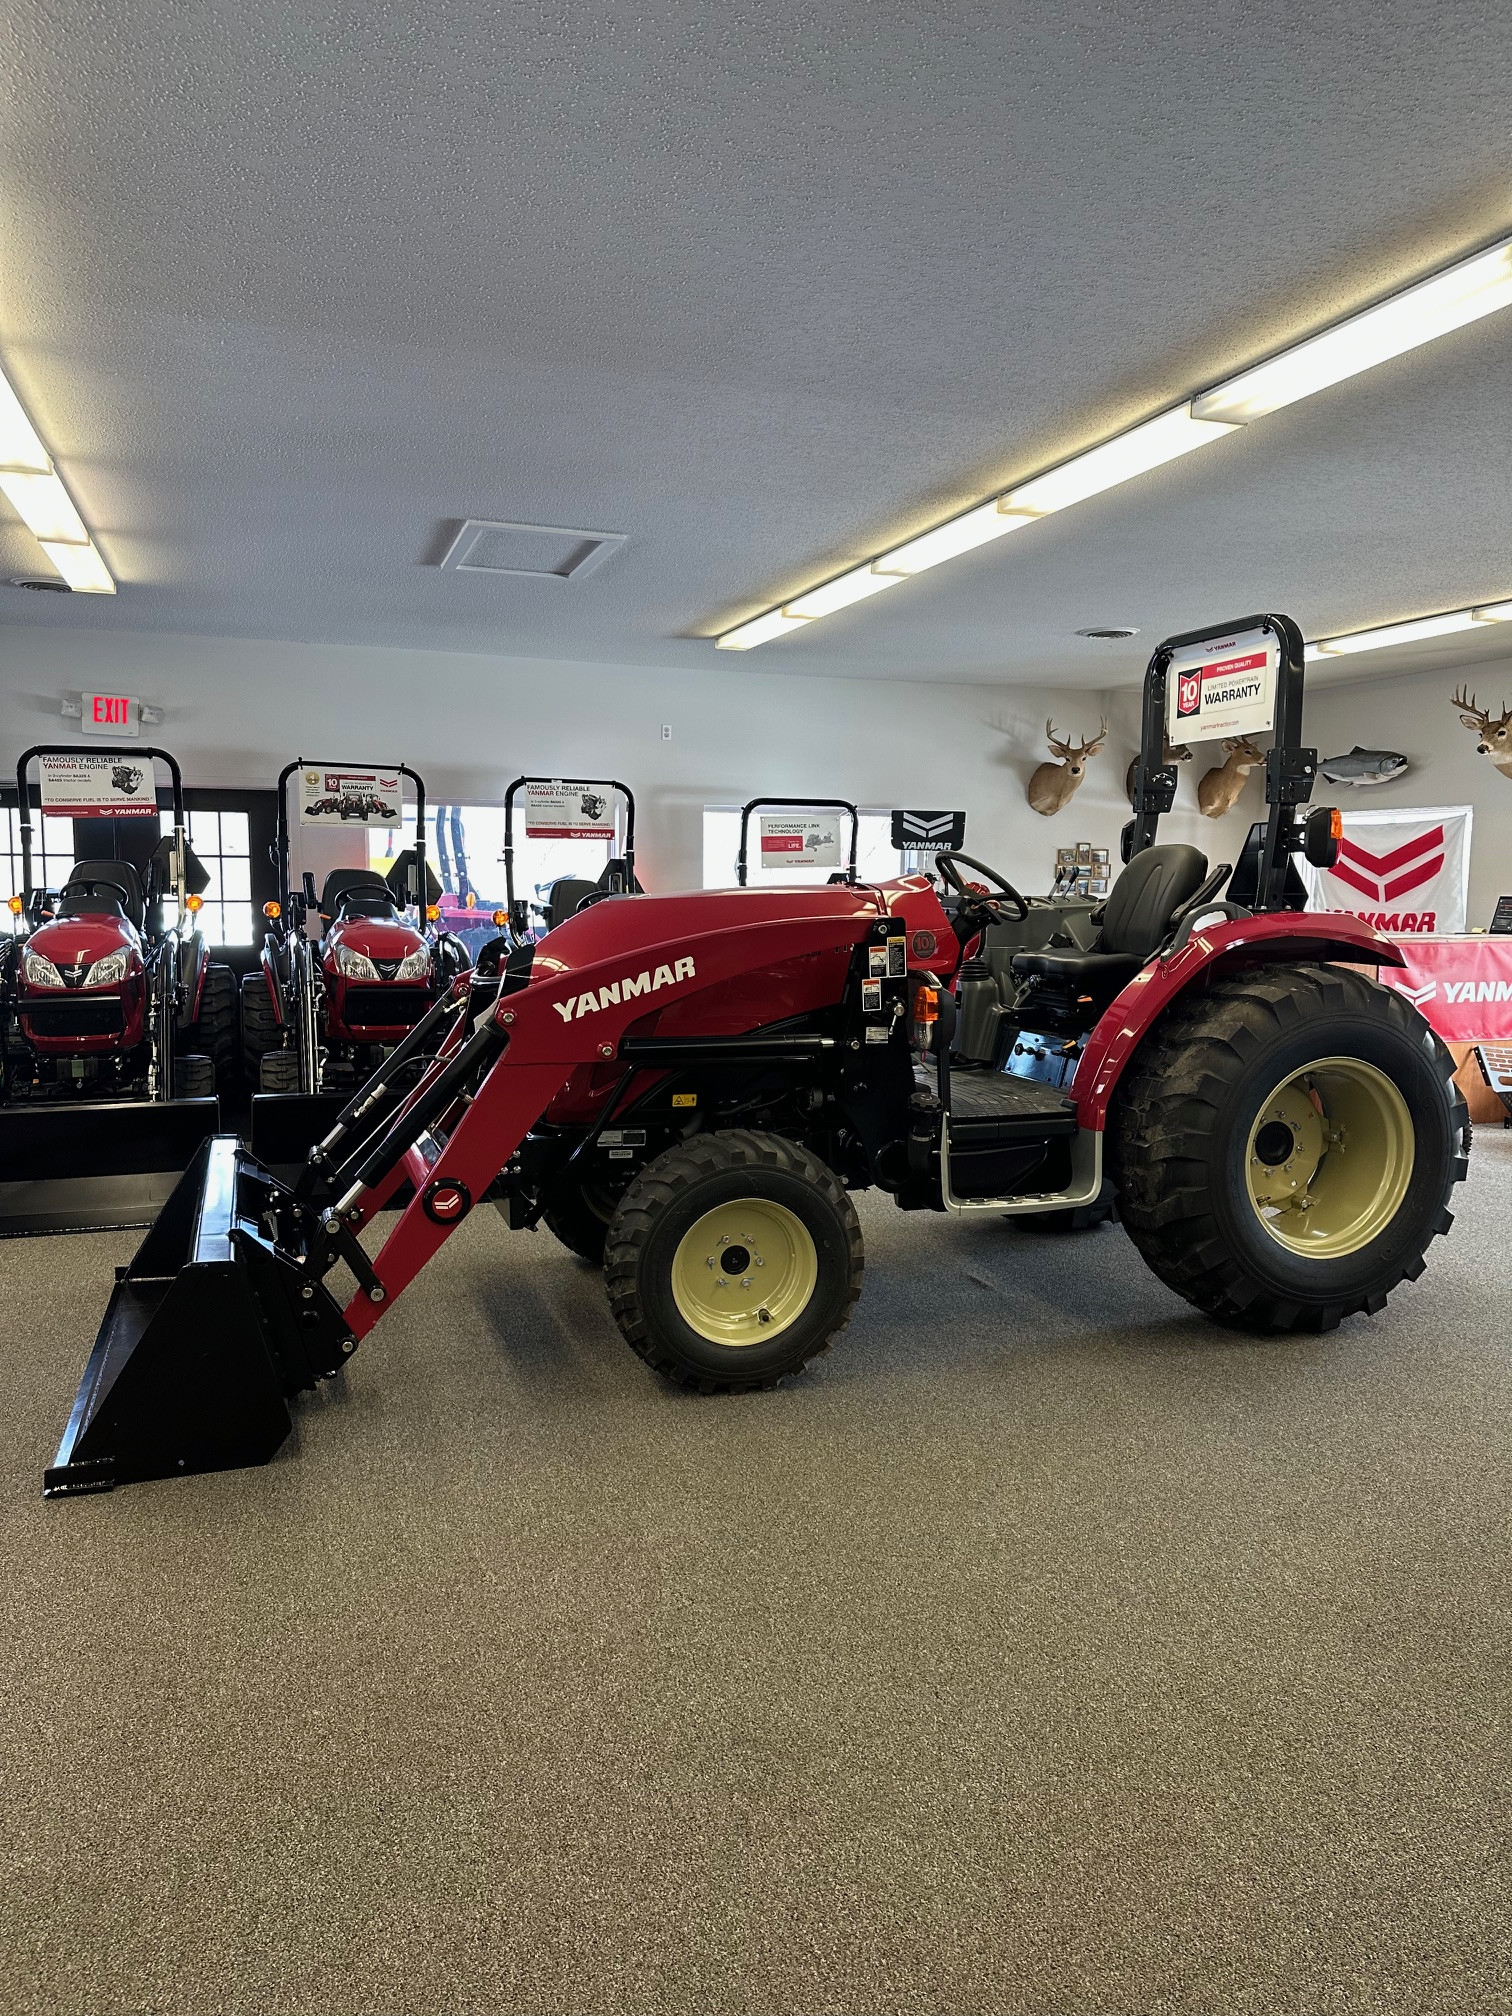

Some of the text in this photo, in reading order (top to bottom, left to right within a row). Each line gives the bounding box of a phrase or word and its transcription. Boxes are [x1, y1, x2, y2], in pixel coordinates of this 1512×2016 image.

[1214, 641, 1236, 652] YANMAR
[1216, 659, 1252, 673] PROVEN QUALITY
[1207, 675, 1259, 691] LIMITED POWERTRAIN
[1181, 680, 1198, 702] 10
[1204, 683, 1261, 705] WARRANTY
[93, 696, 130, 725] EXIT
[1183, 700, 1195, 709] YEAR
[327, 778, 338, 787] 10
[902, 841, 952, 850] YANMAR
[916, 937, 929, 950] 10
[552, 956, 696, 1023] YANMAR
